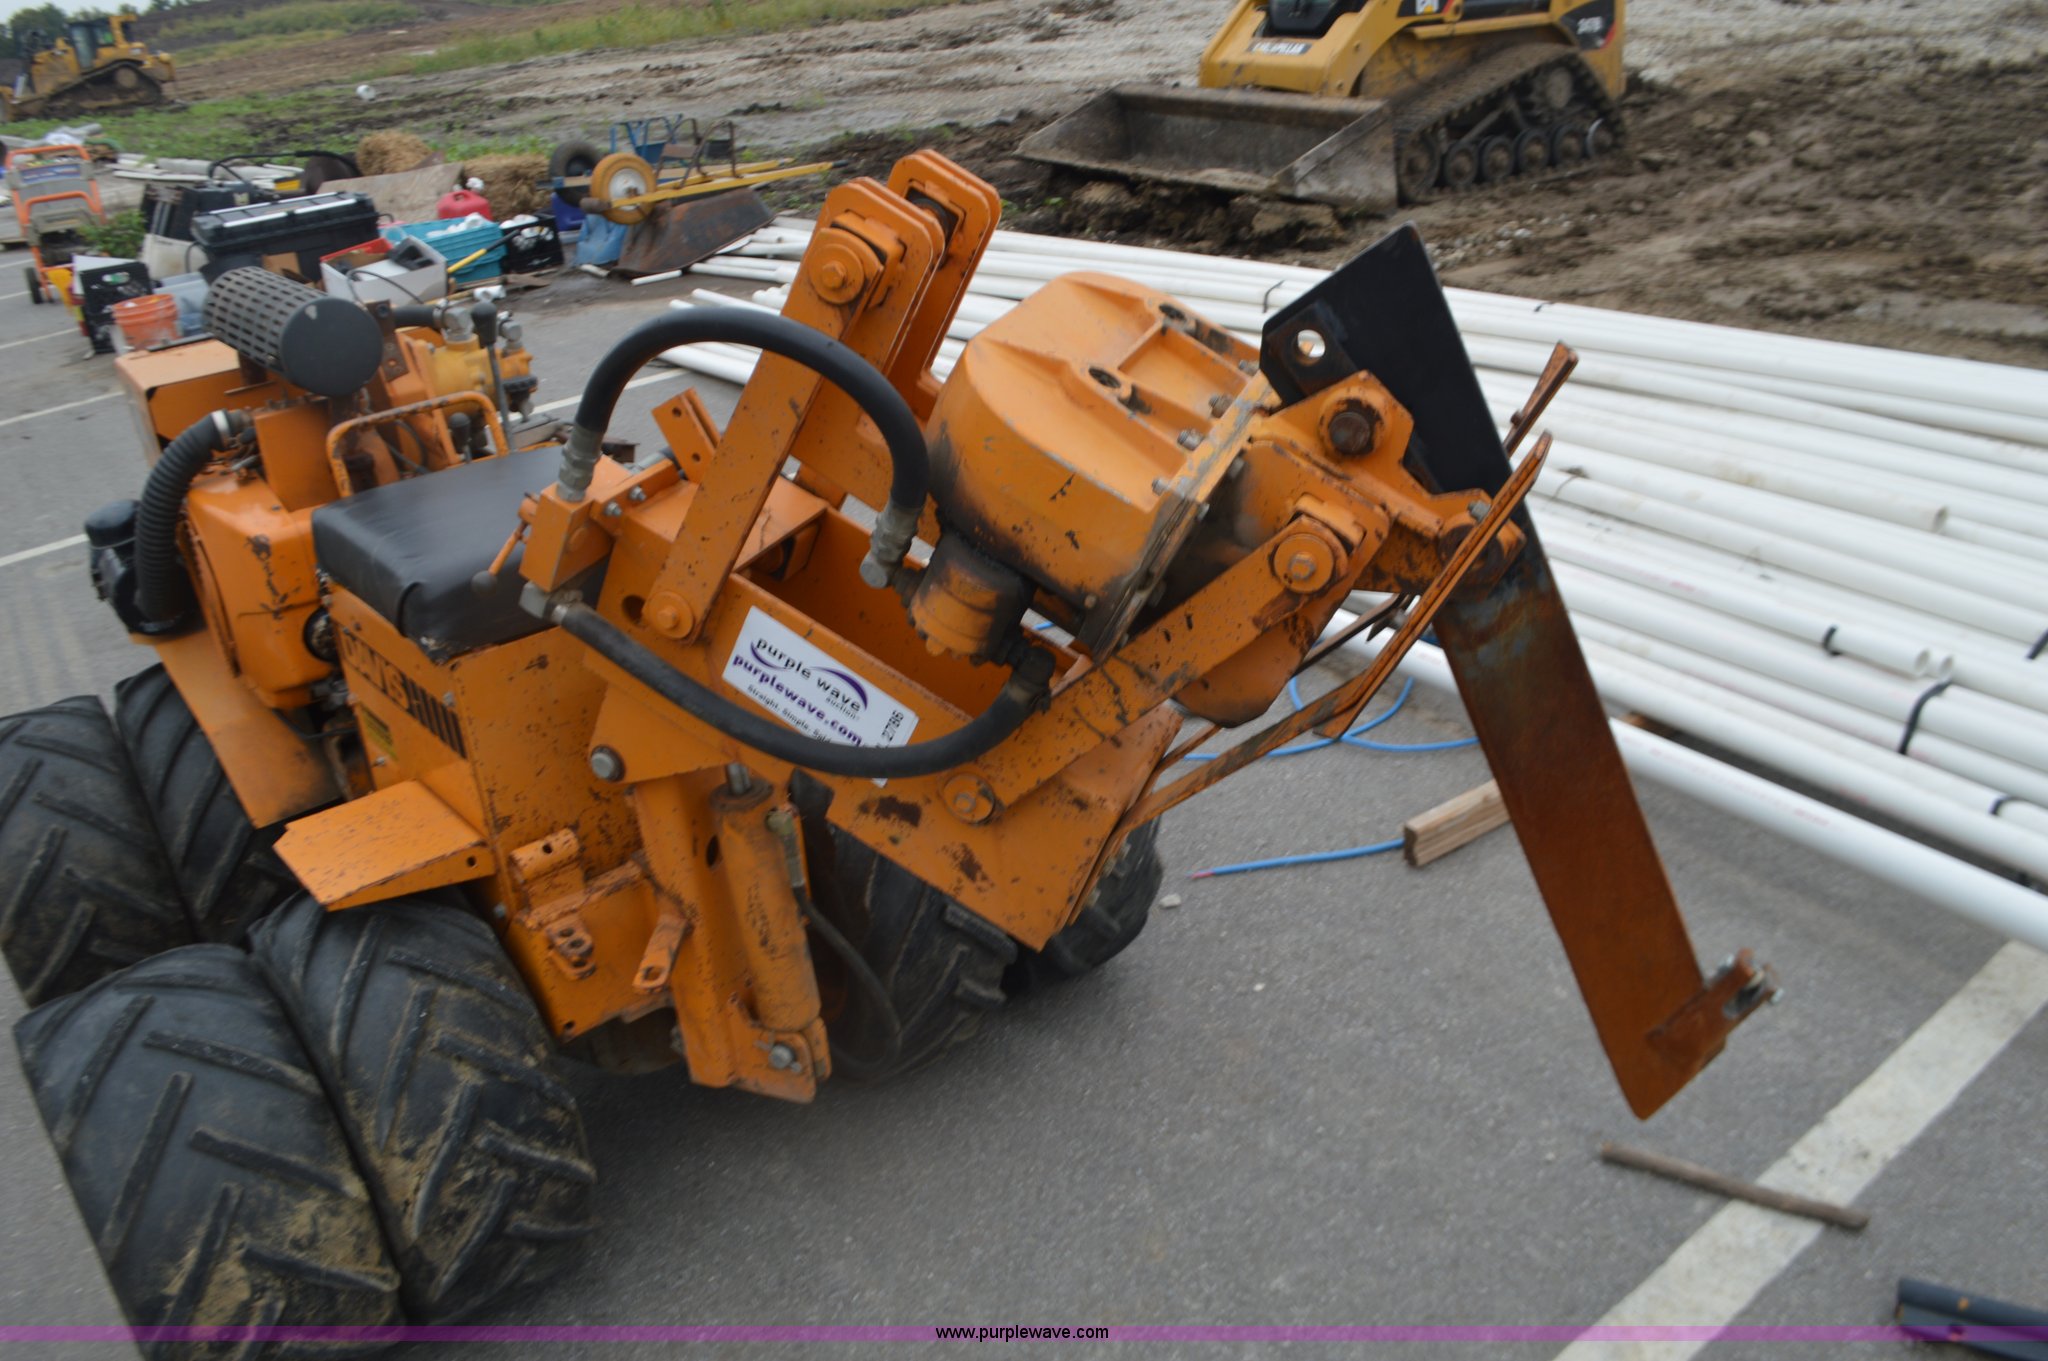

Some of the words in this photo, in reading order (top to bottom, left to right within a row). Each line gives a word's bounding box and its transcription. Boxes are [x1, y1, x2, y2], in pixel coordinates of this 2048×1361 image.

[733, 654, 862, 747] purplewave.com
[757, 638, 812, 679] purple
[817, 677, 862, 712] wave
